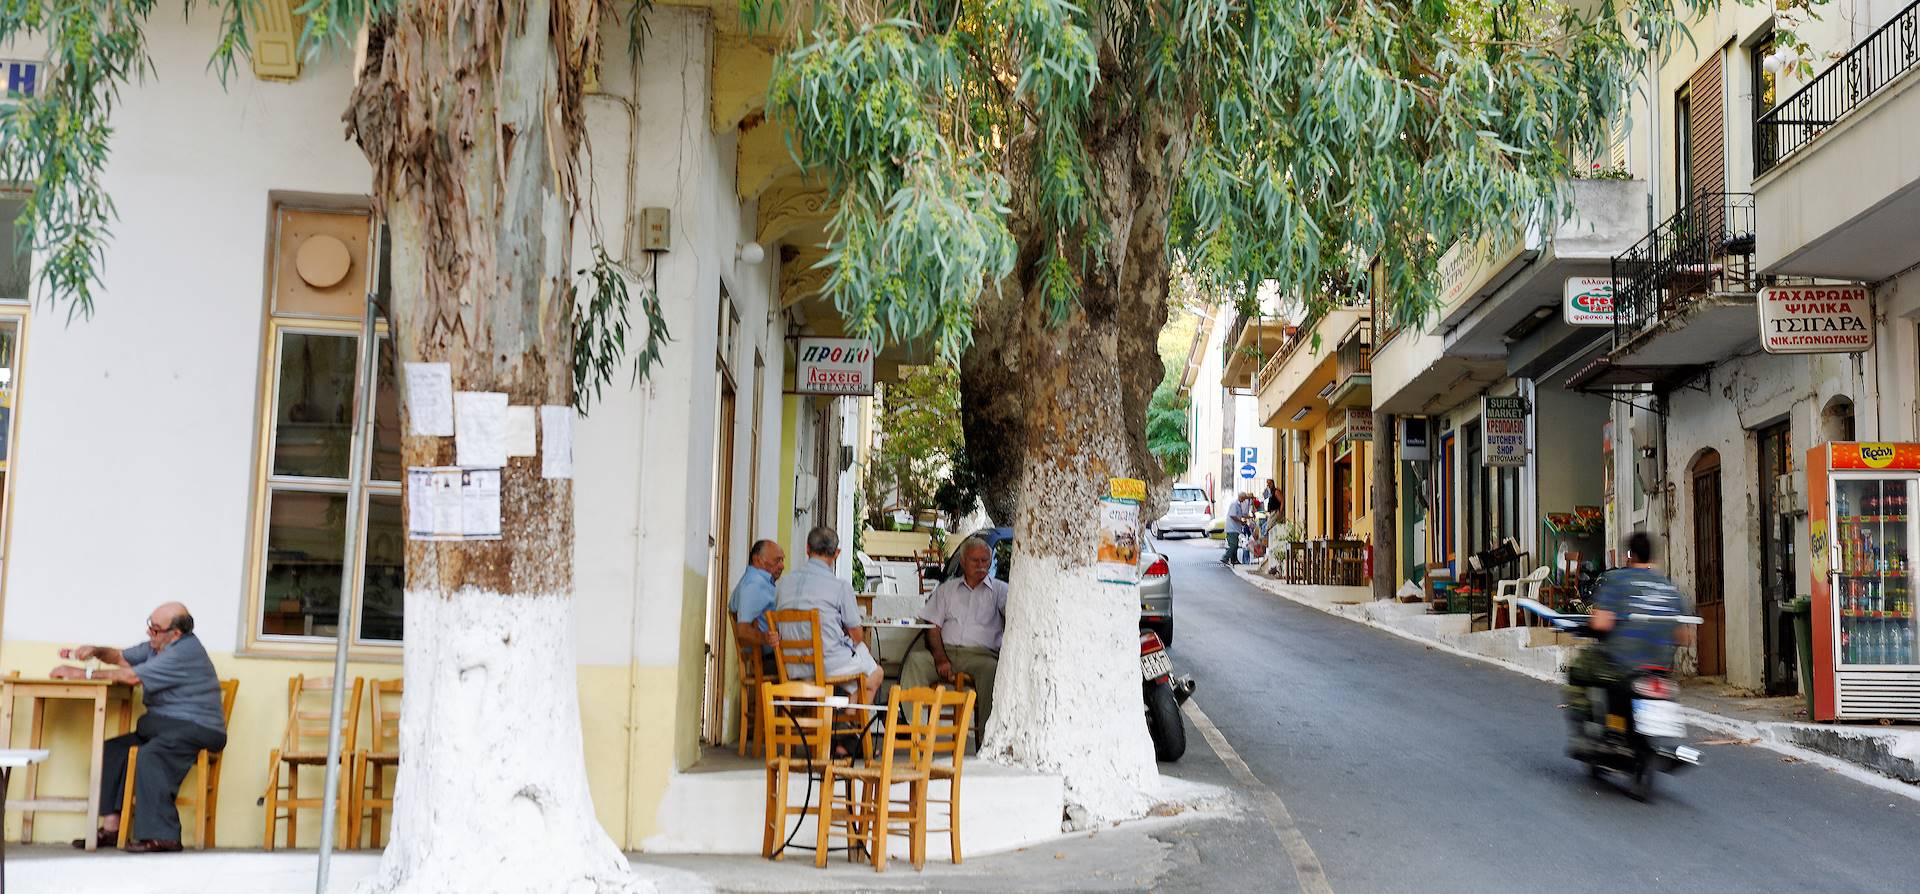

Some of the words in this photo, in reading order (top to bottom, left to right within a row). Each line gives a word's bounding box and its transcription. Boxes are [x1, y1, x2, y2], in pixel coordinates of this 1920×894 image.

[1768, 290, 1865, 301] ΖΑΧΑΡΩΔΗ
[1785, 303, 1852, 314] ΨΙΛΙΚΑ
[1770, 316, 1866, 332] ΤΣΙΓΑΡΑ
[1490, 399, 1519, 408] SUPER
[1487, 409, 1522, 418] MARKET
[1497, 445, 1513, 454] SHOP
